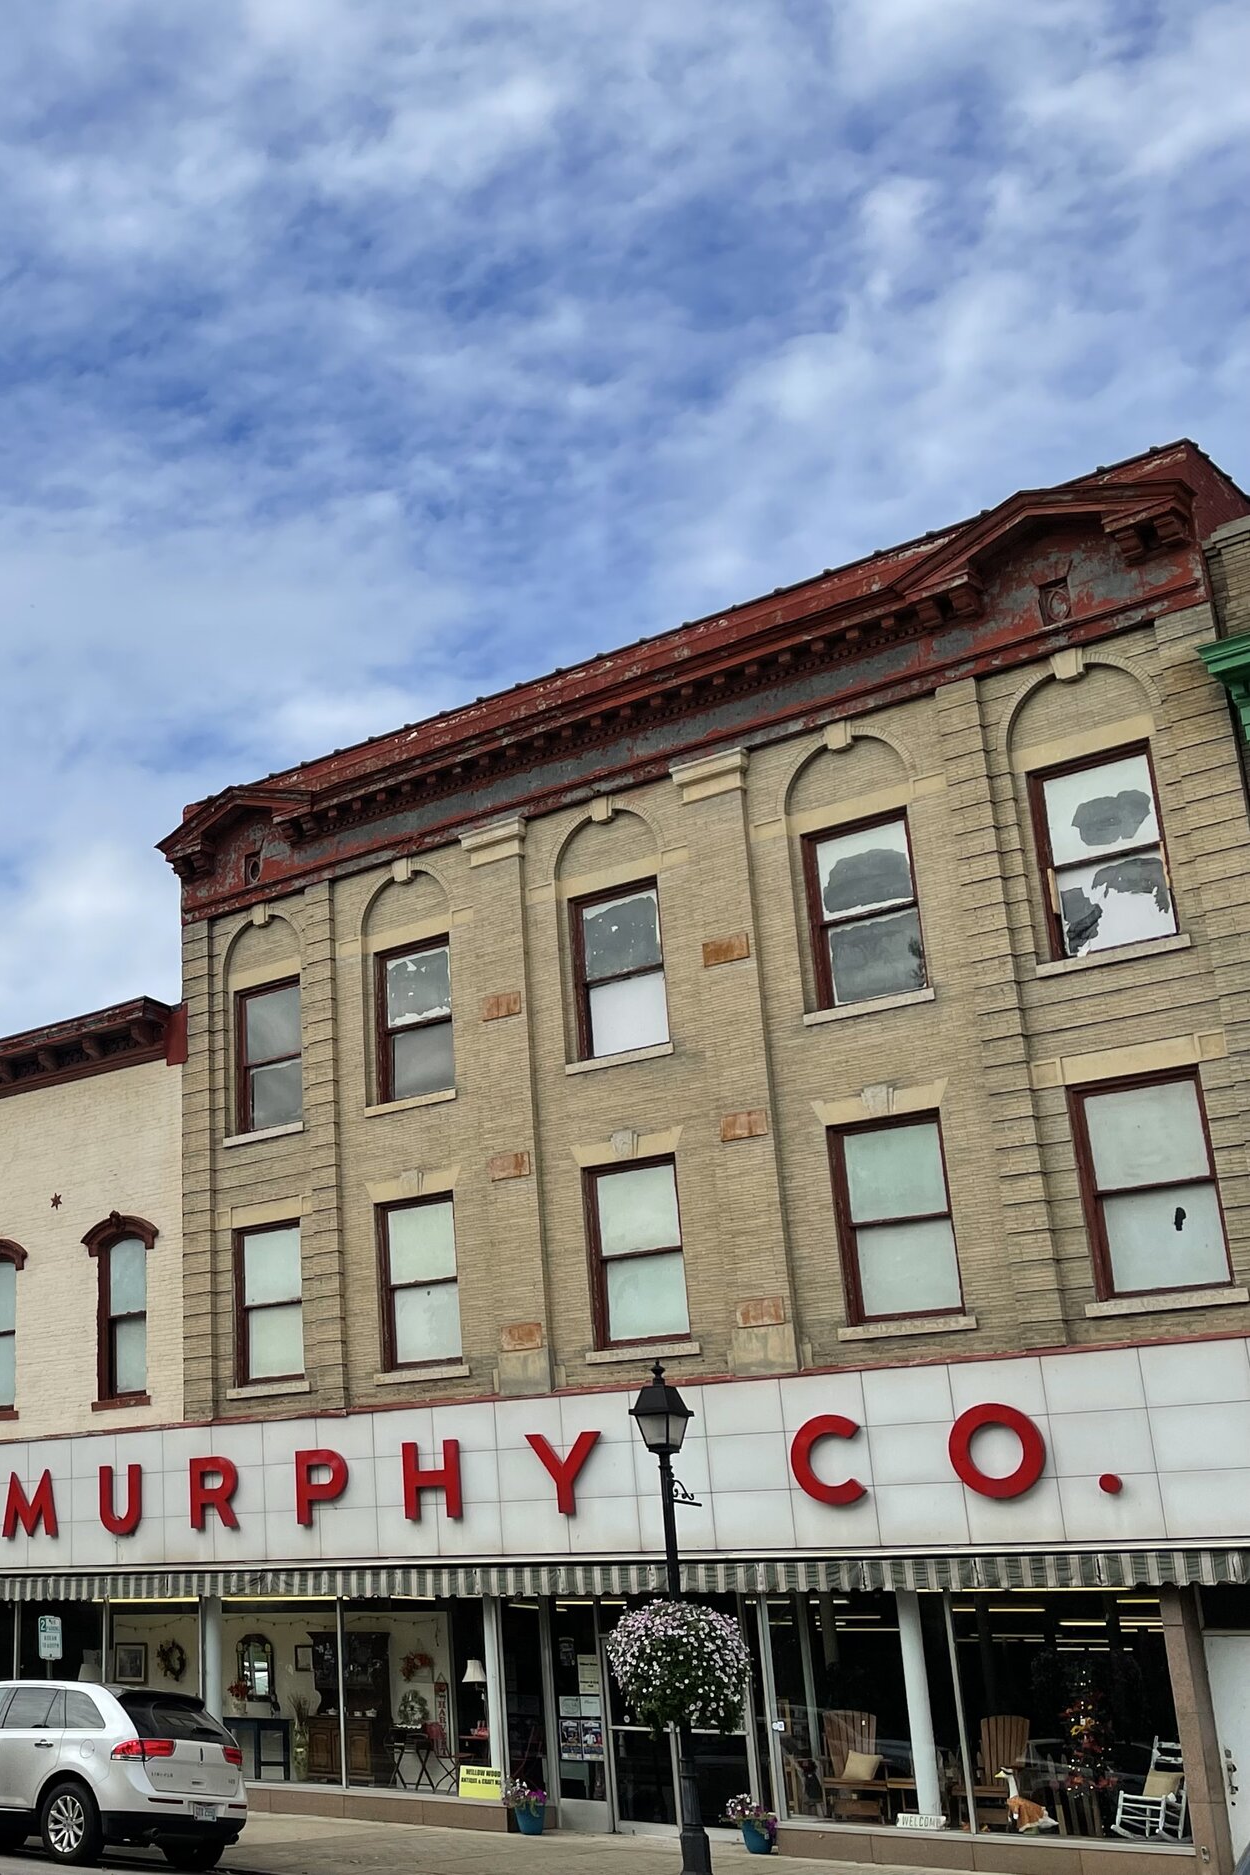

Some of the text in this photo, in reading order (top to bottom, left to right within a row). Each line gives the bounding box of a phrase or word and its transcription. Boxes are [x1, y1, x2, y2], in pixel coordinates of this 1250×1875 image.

[2, 1430, 602, 1539] MURPHY
[791, 1402, 1123, 1505] CO.
[40, 1619, 47, 1631] 2
